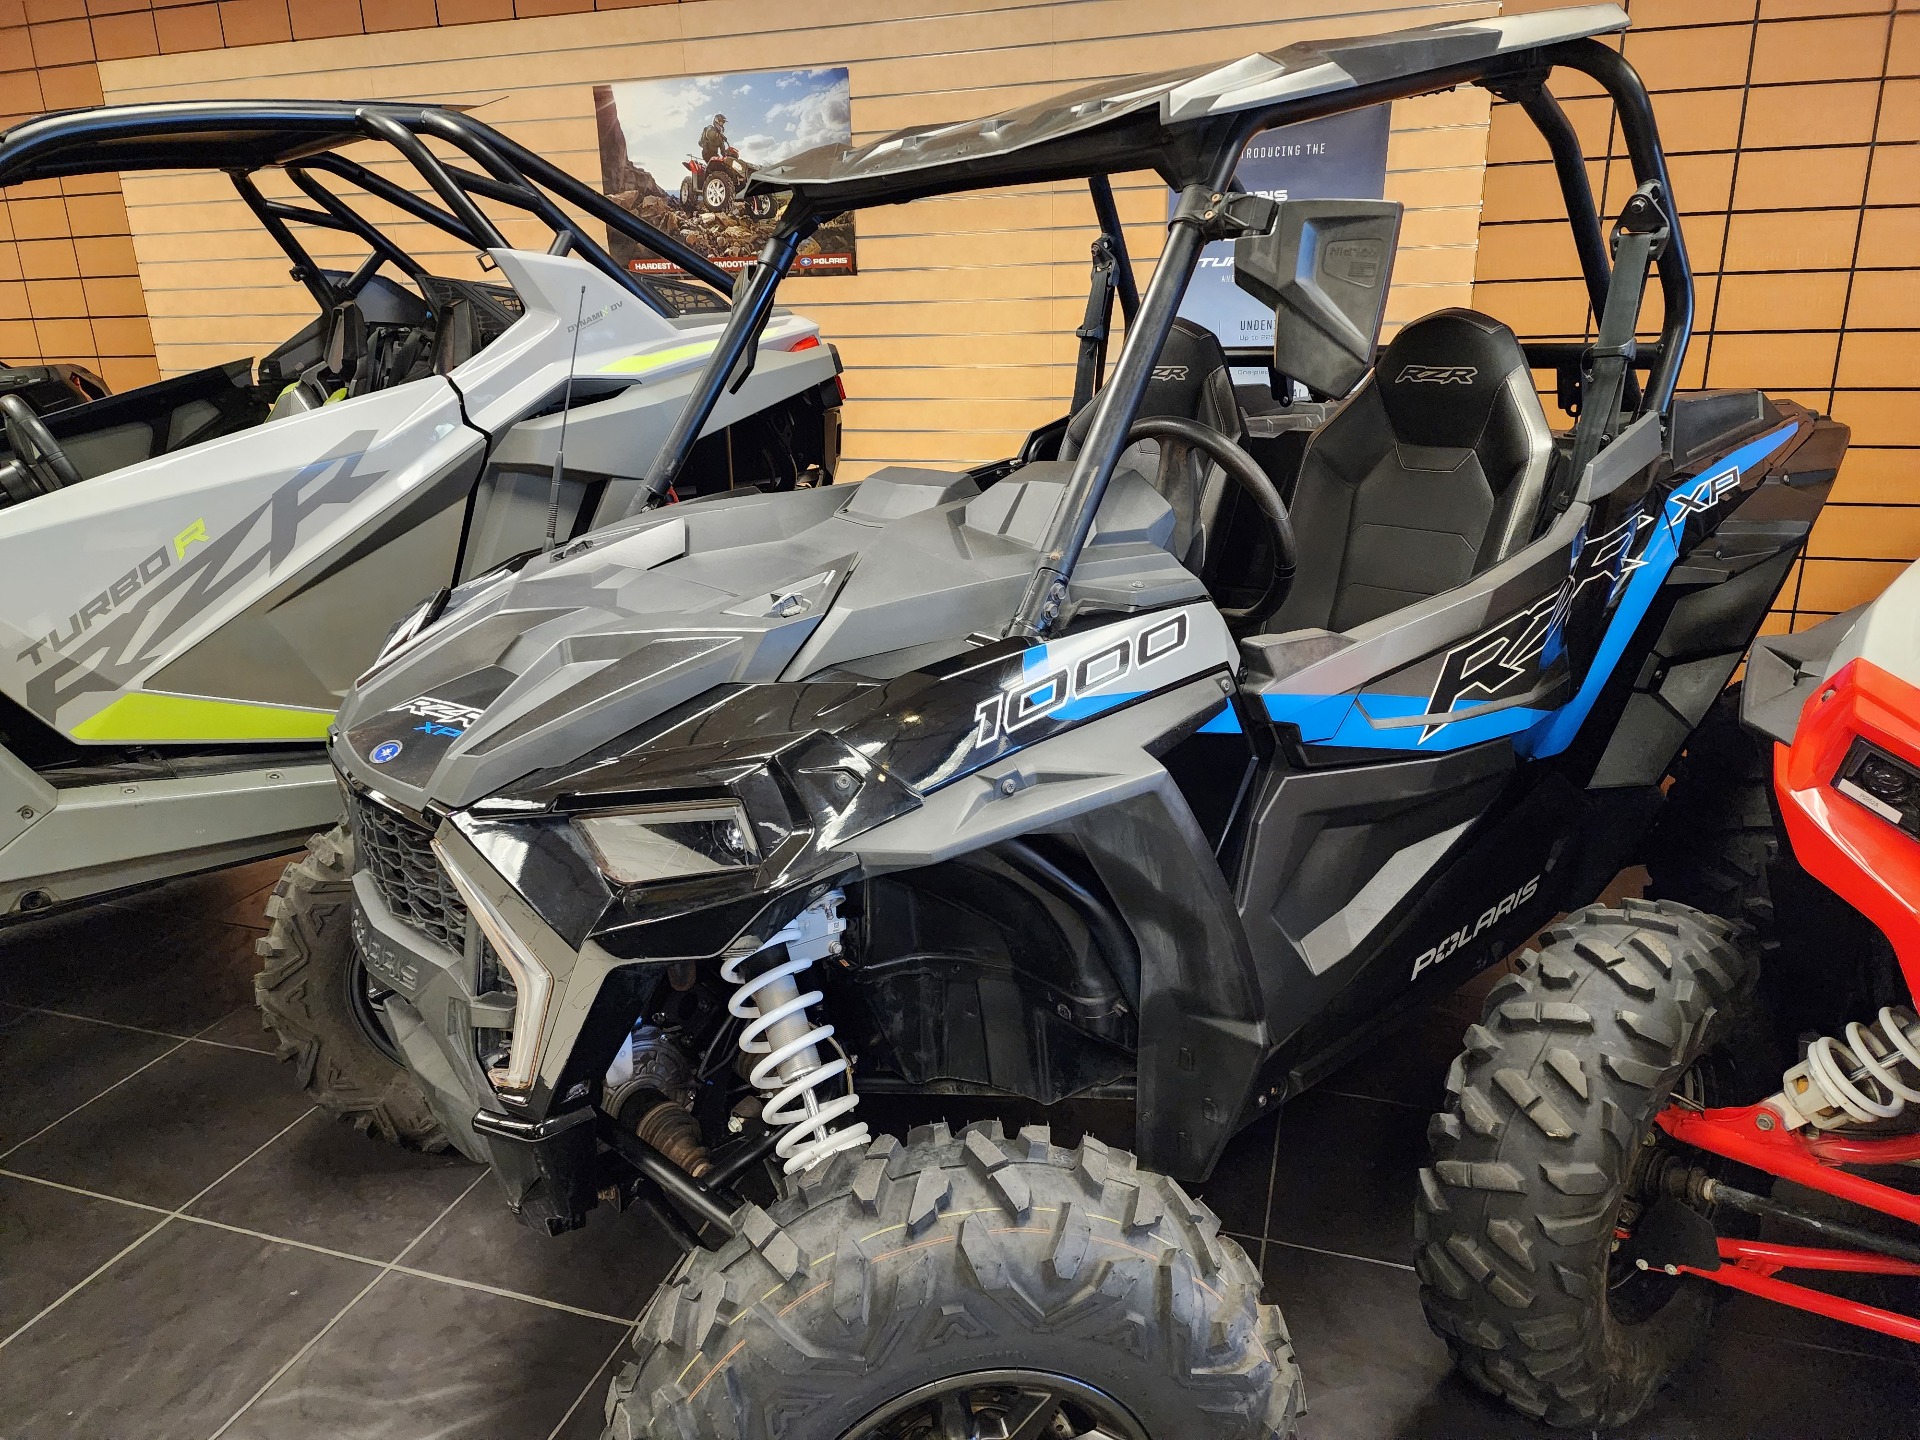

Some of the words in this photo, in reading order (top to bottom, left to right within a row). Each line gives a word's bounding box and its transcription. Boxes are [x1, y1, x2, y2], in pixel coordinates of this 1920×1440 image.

[1306, 143, 1326, 155] THE
[634, 262, 673, 270] HARDEST
[812, 257, 848, 265] POLARIS
[566, 305, 609, 334] DYNAMIX
[610, 300, 623, 312] DV
[1240, 318, 1275, 331] UNDEN
[1150, 365, 1190, 382] ZR
[1394, 363, 1479, 386] RZR
[1666, 464, 1741, 530] XP
[26, 430, 389, 726] RZR
[16, 545, 171, 667] TURBO
[974, 609, 1190, 749] 1000
[412, 721, 465, 738] XP
[1410, 874, 1541, 982] POLARIS
